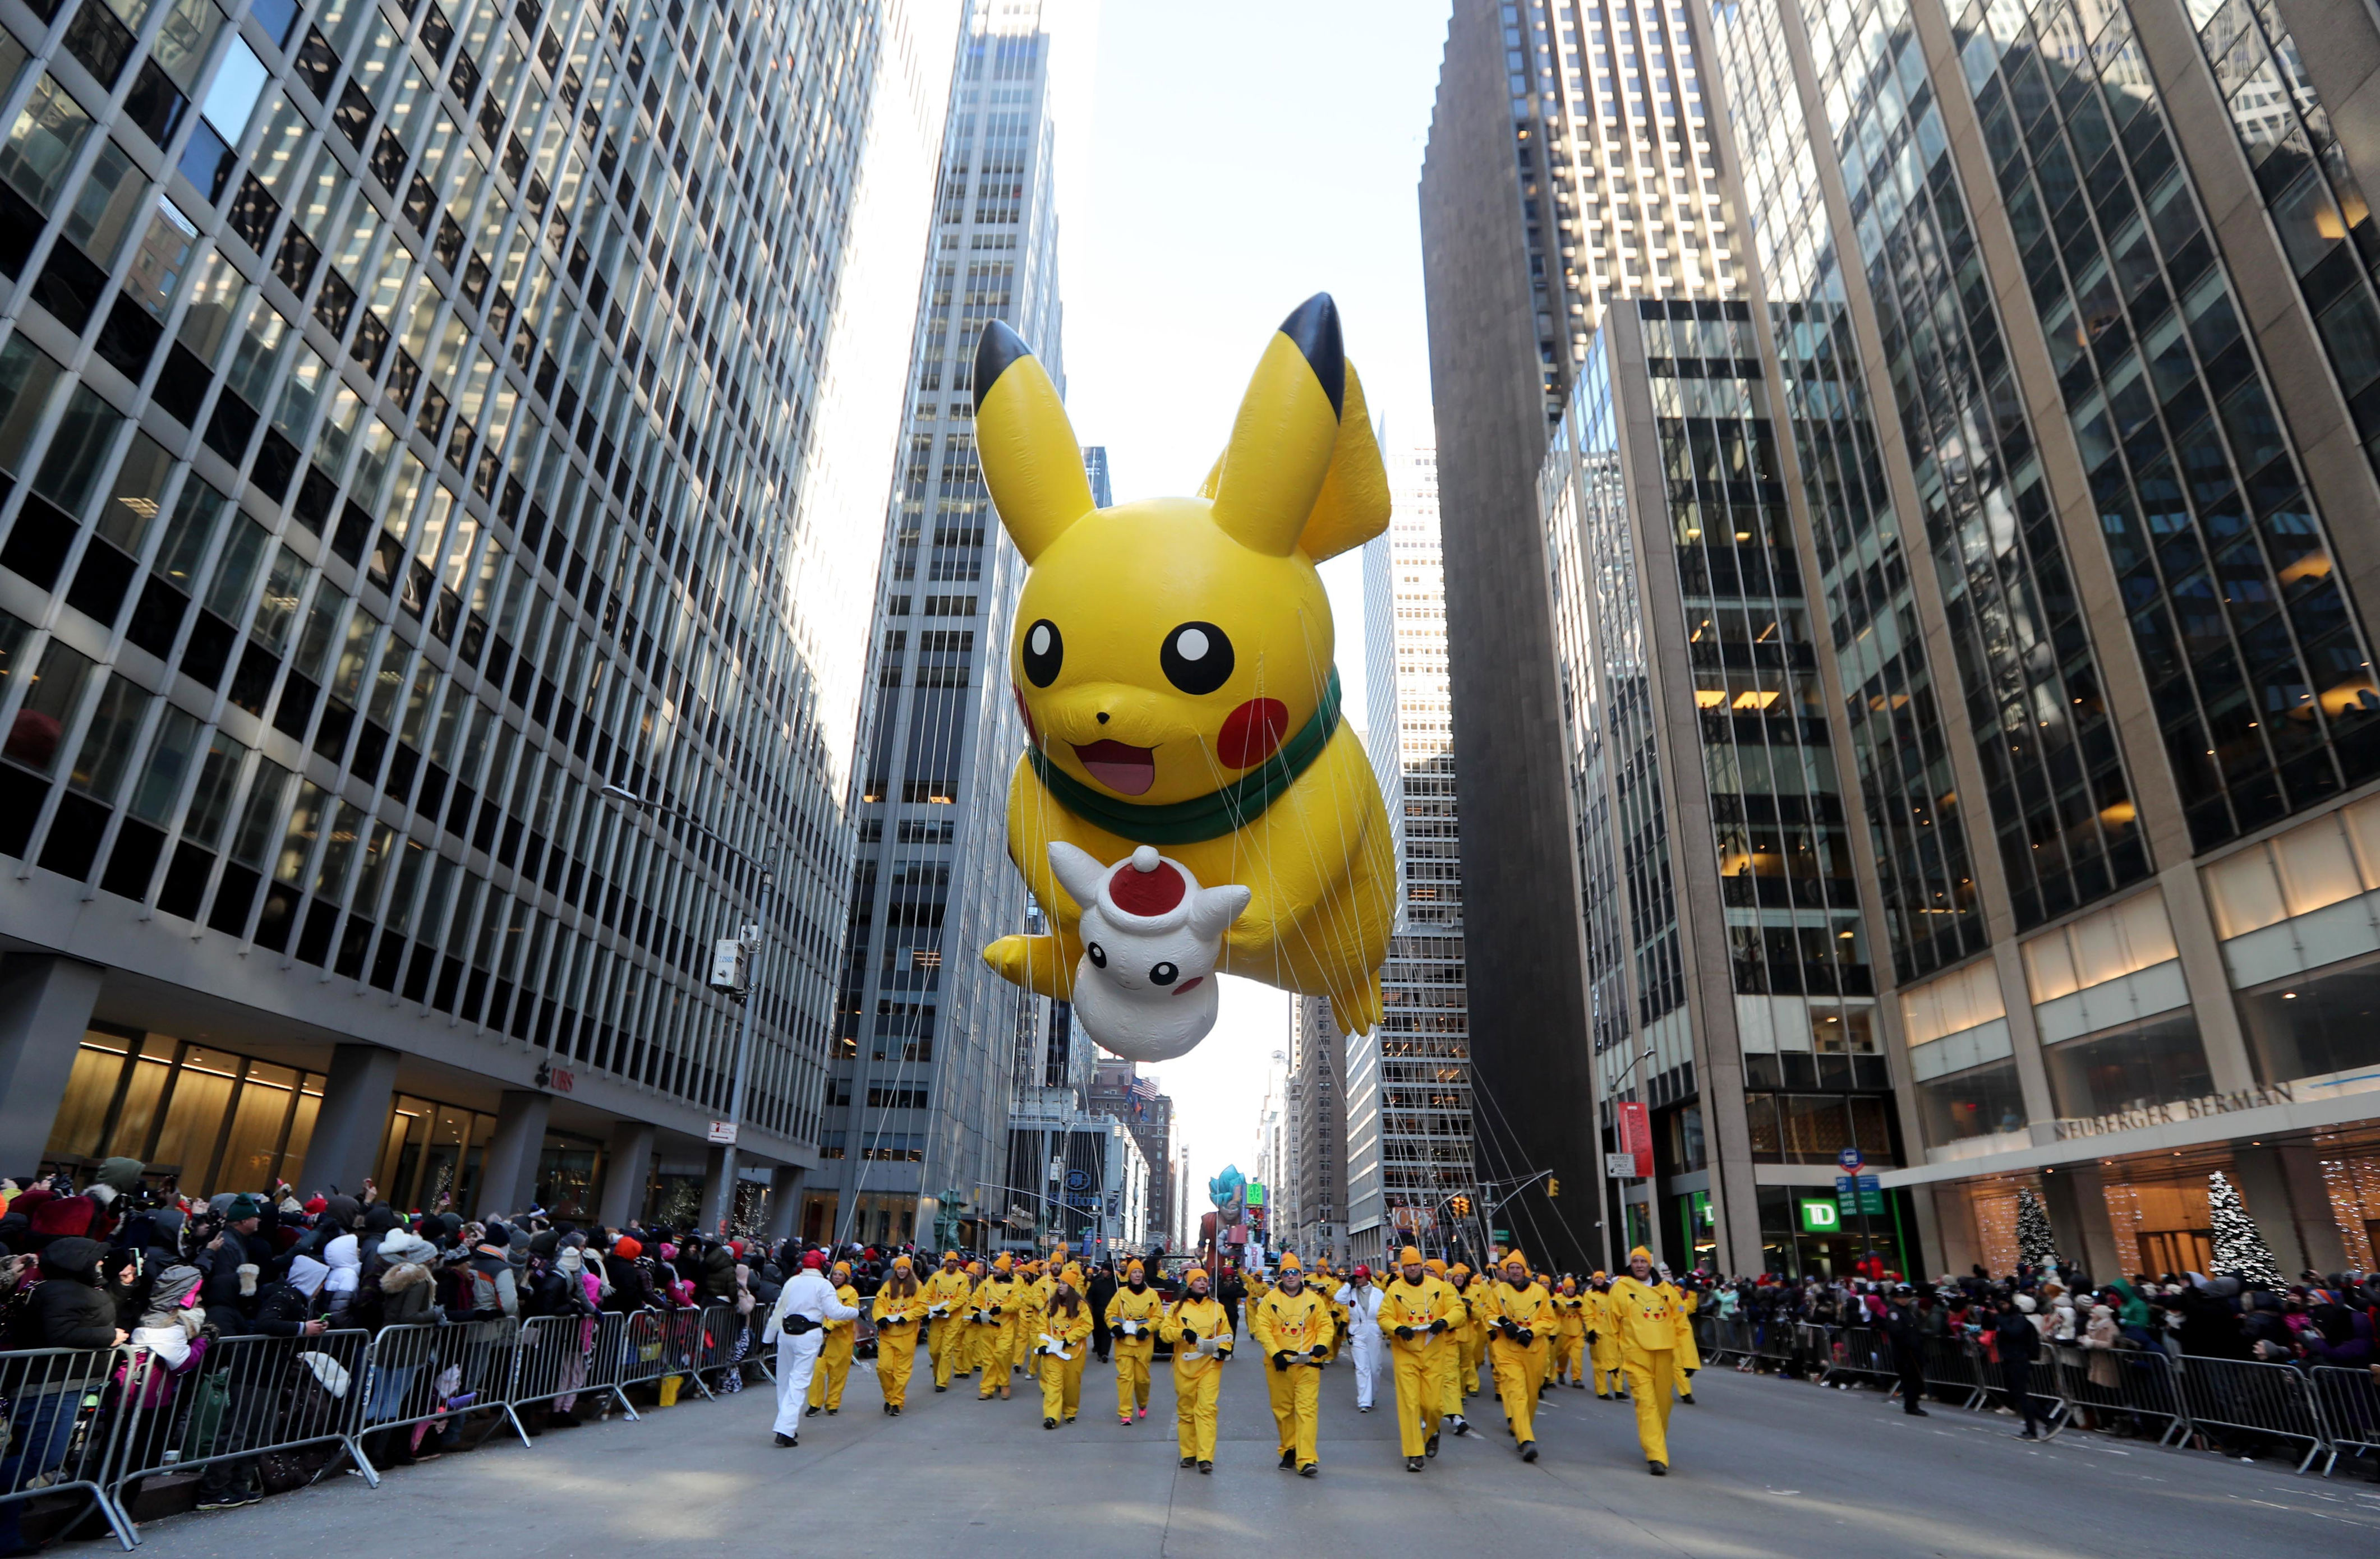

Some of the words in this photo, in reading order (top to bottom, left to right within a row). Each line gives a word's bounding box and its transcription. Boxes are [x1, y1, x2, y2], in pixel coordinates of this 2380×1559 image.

[551, 1068, 574, 1092] UBS
[2055, 1105, 2174, 1141] NEUBERGER
[2187, 1081, 2295, 1119] BERMAN
[1048, 1192, 1102, 1207] Hlton
[1704, 1206, 1715, 1221] T
[1803, 1204, 1835, 1225] TD
